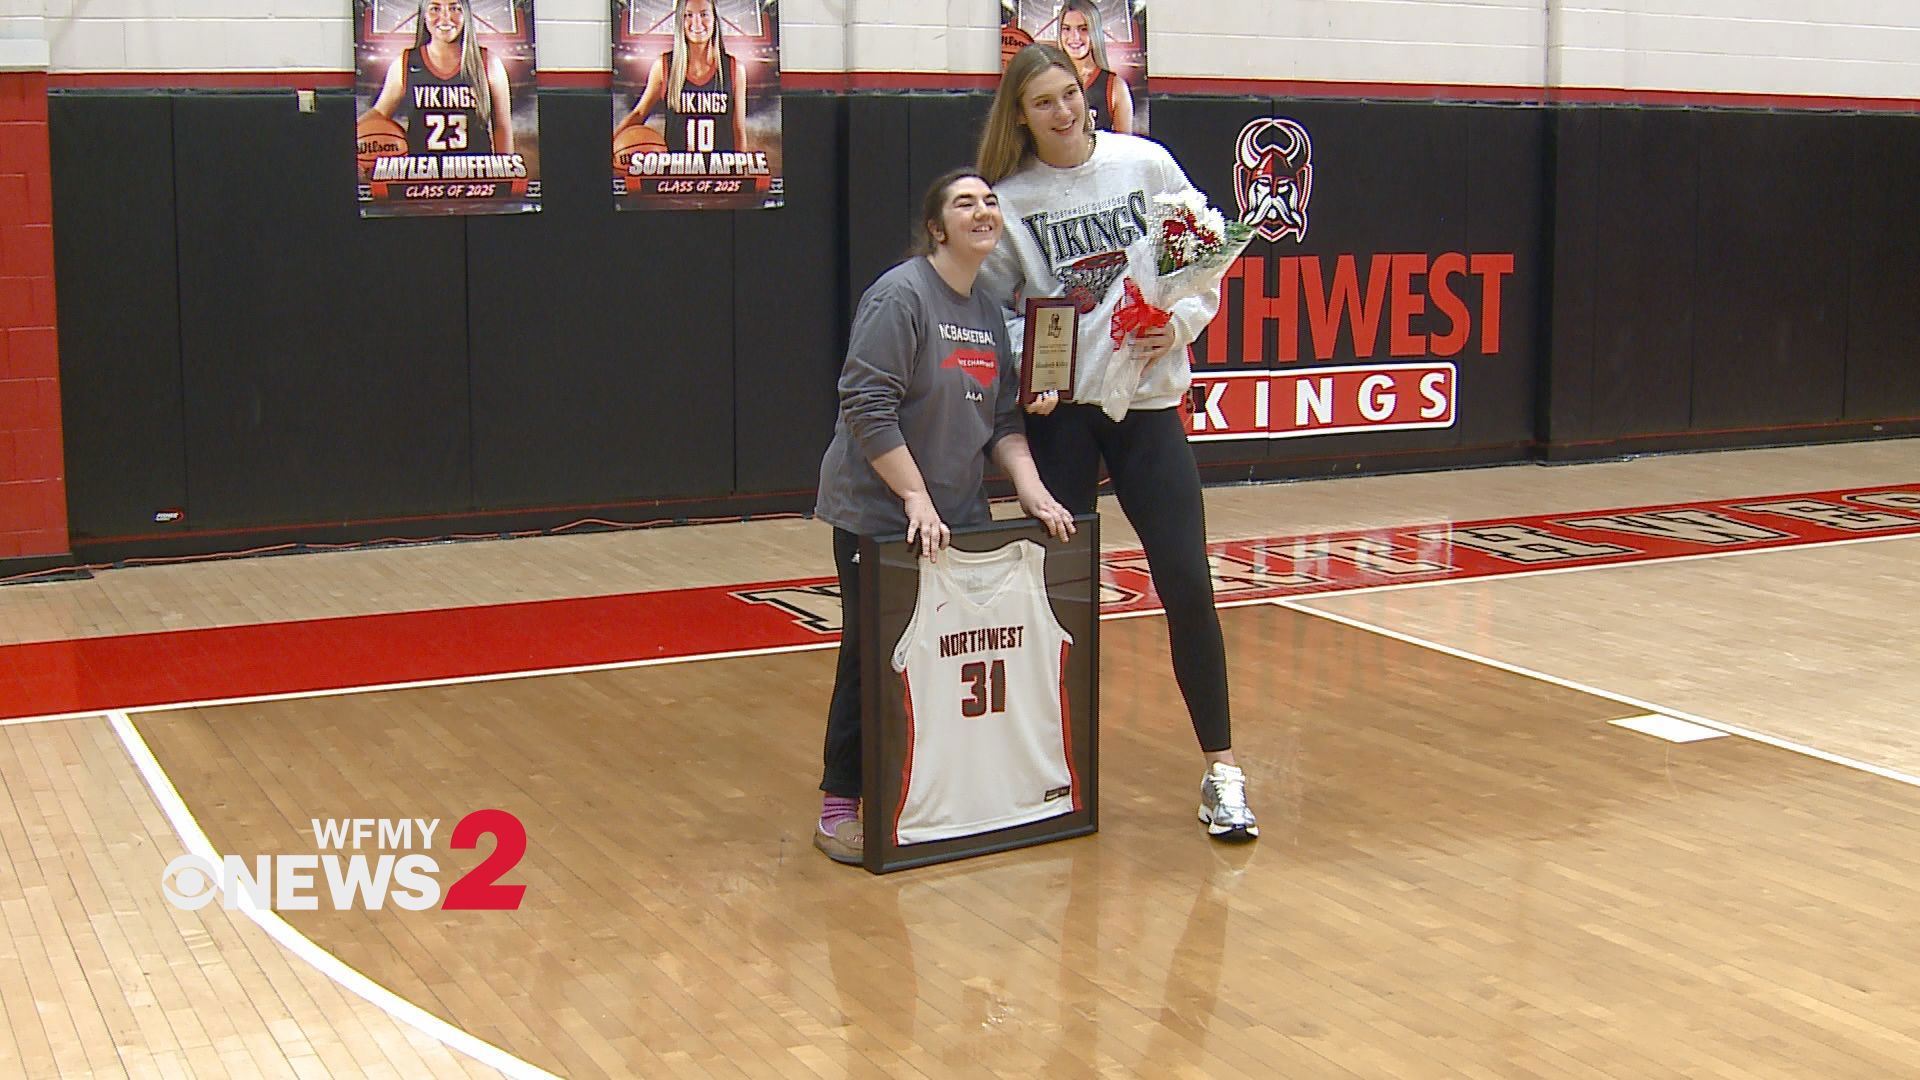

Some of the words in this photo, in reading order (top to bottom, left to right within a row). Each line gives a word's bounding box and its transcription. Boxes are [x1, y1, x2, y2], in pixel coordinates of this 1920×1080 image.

[1001, 36, 1031, 48] ilso
[675, 91, 728, 114] IKINGS
[425, 113, 468, 151] 23
[687, 118, 715, 152] 10
[373, 155, 440, 181] HAYLEA
[441, 153, 528, 180] HUFFINES
[629, 151, 708, 176] SOPHIA
[708, 151, 770, 176] APPLE
[405, 184, 444, 199] CLASS
[448, 185, 464, 198] OF
[465, 184, 497, 198] 2025
[657, 180, 694, 195] CLASS
[697, 180, 712, 193] OF
[714, 179, 743, 193] 2025
[1021, 189, 1148, 277] VIKINGS
[1188, 251, 1514, 364] THWEST
[939, 625, 1025, 658] NORTHWEST
[961, 659, 1006, 718] 31
